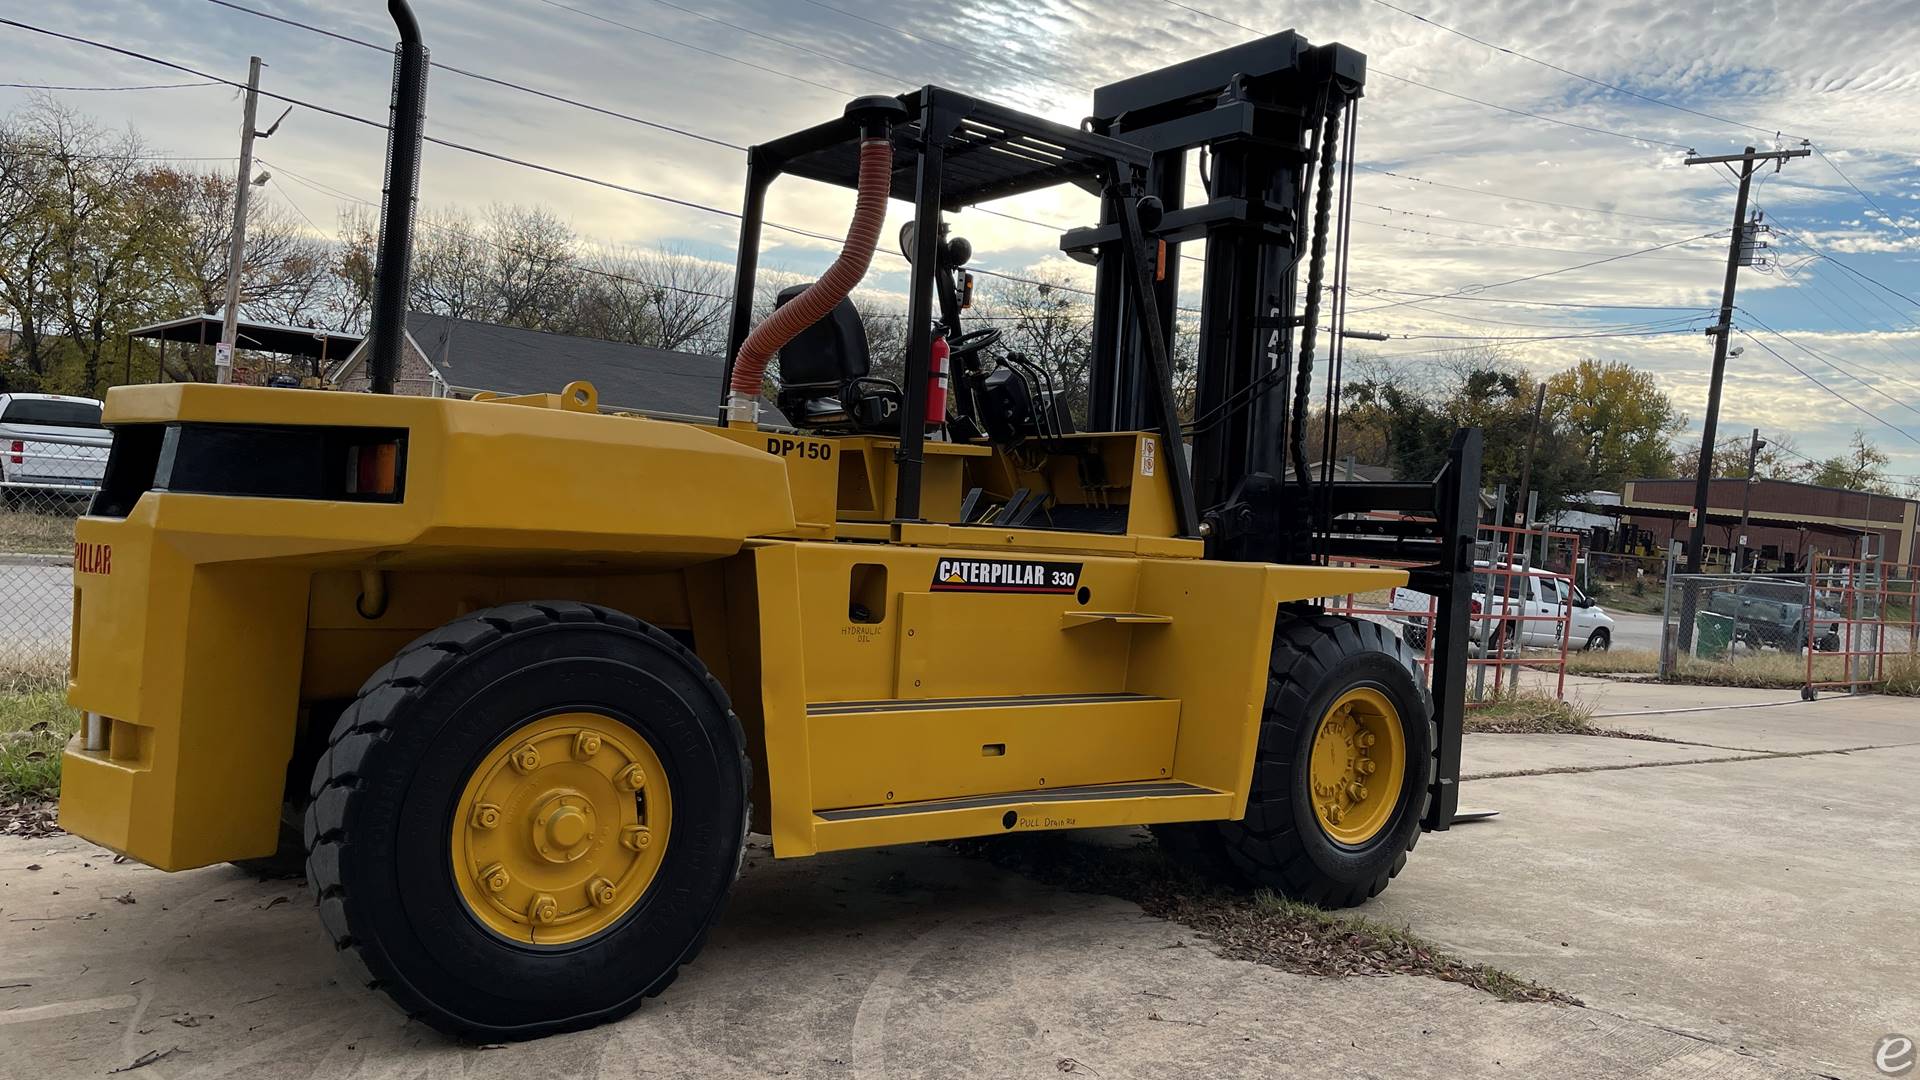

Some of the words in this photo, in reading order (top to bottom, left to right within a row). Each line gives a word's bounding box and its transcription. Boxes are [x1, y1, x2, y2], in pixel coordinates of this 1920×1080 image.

[767, 438, 831, 461] DP150
[939, 560, 1045, 585] CATERPILLAR
[1051, 571, 1075, 587] 330
[841, 626, 881, 636] HYDRAULIC
[858, 635, 871, 643] OIL
